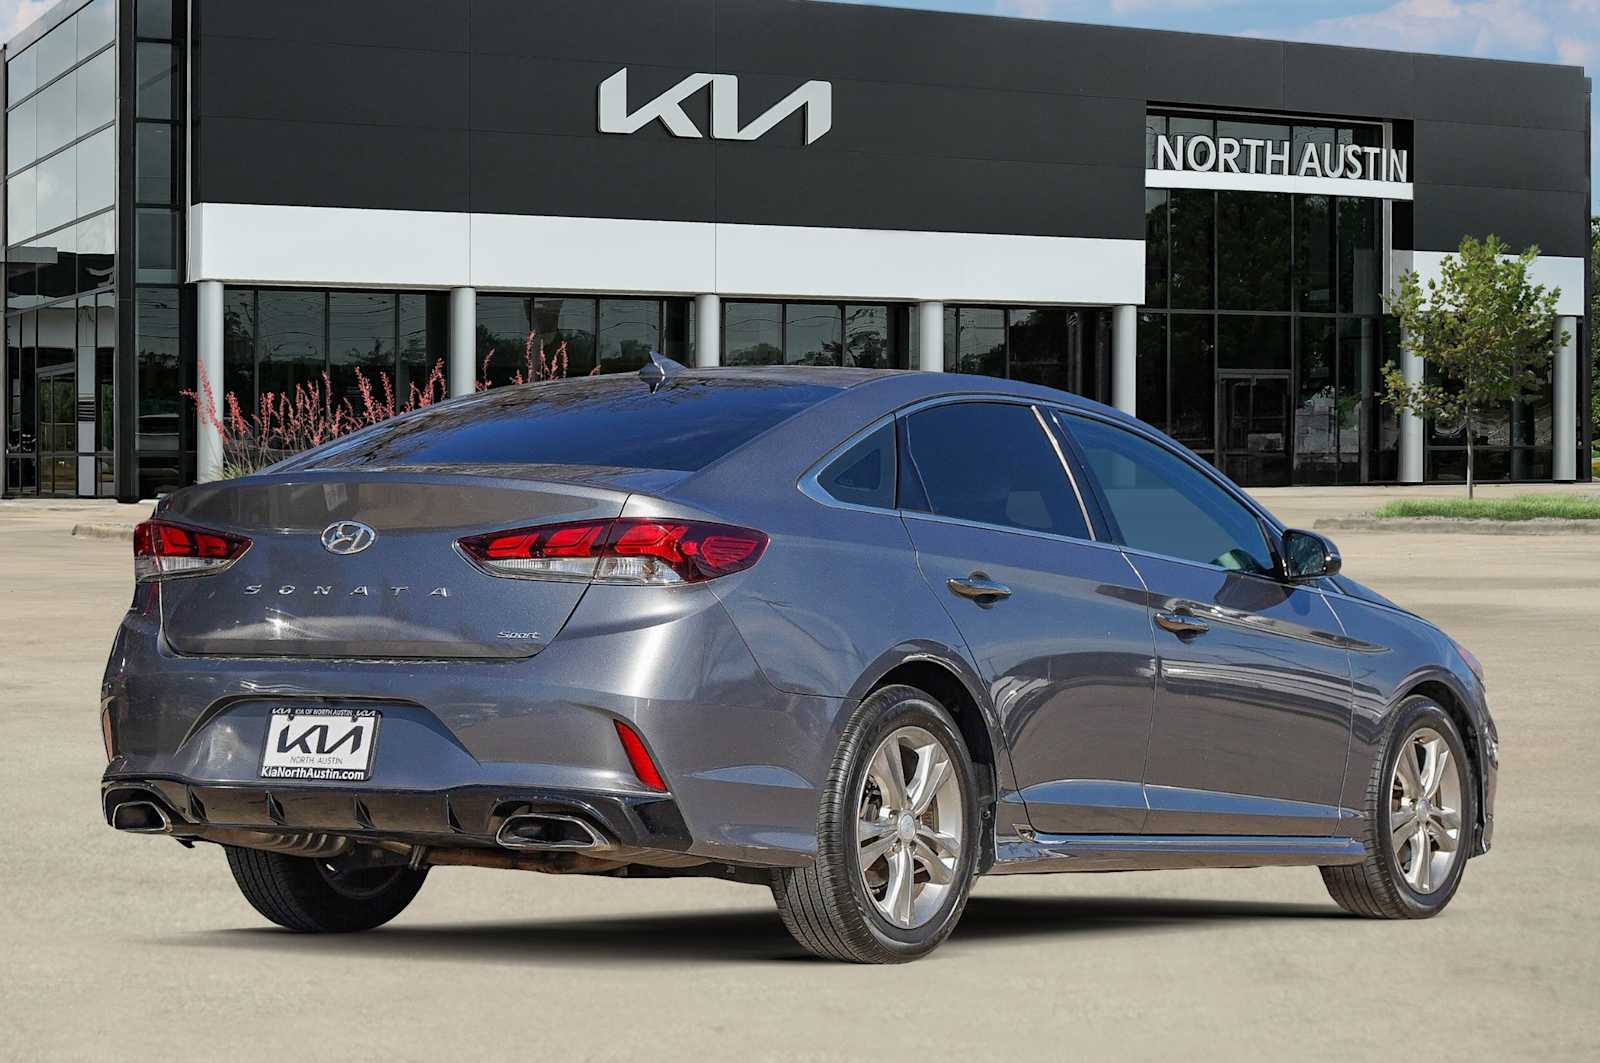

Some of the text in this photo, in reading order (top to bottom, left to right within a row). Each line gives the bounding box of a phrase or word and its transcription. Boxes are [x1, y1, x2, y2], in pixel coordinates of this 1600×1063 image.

[598, 67, 833, 145] KIA
[1156, 134, 1408, 183] NORTH AUSTIN
[244, 584, 449, 597] SONATA
[496, 631, 542, 640] Sport
[277, 724, 364, 755] KIA
[290, 755, 343, 765] NORTH AUSTIN
[261, 766, 365, 780] KiaNorthAustin.com
